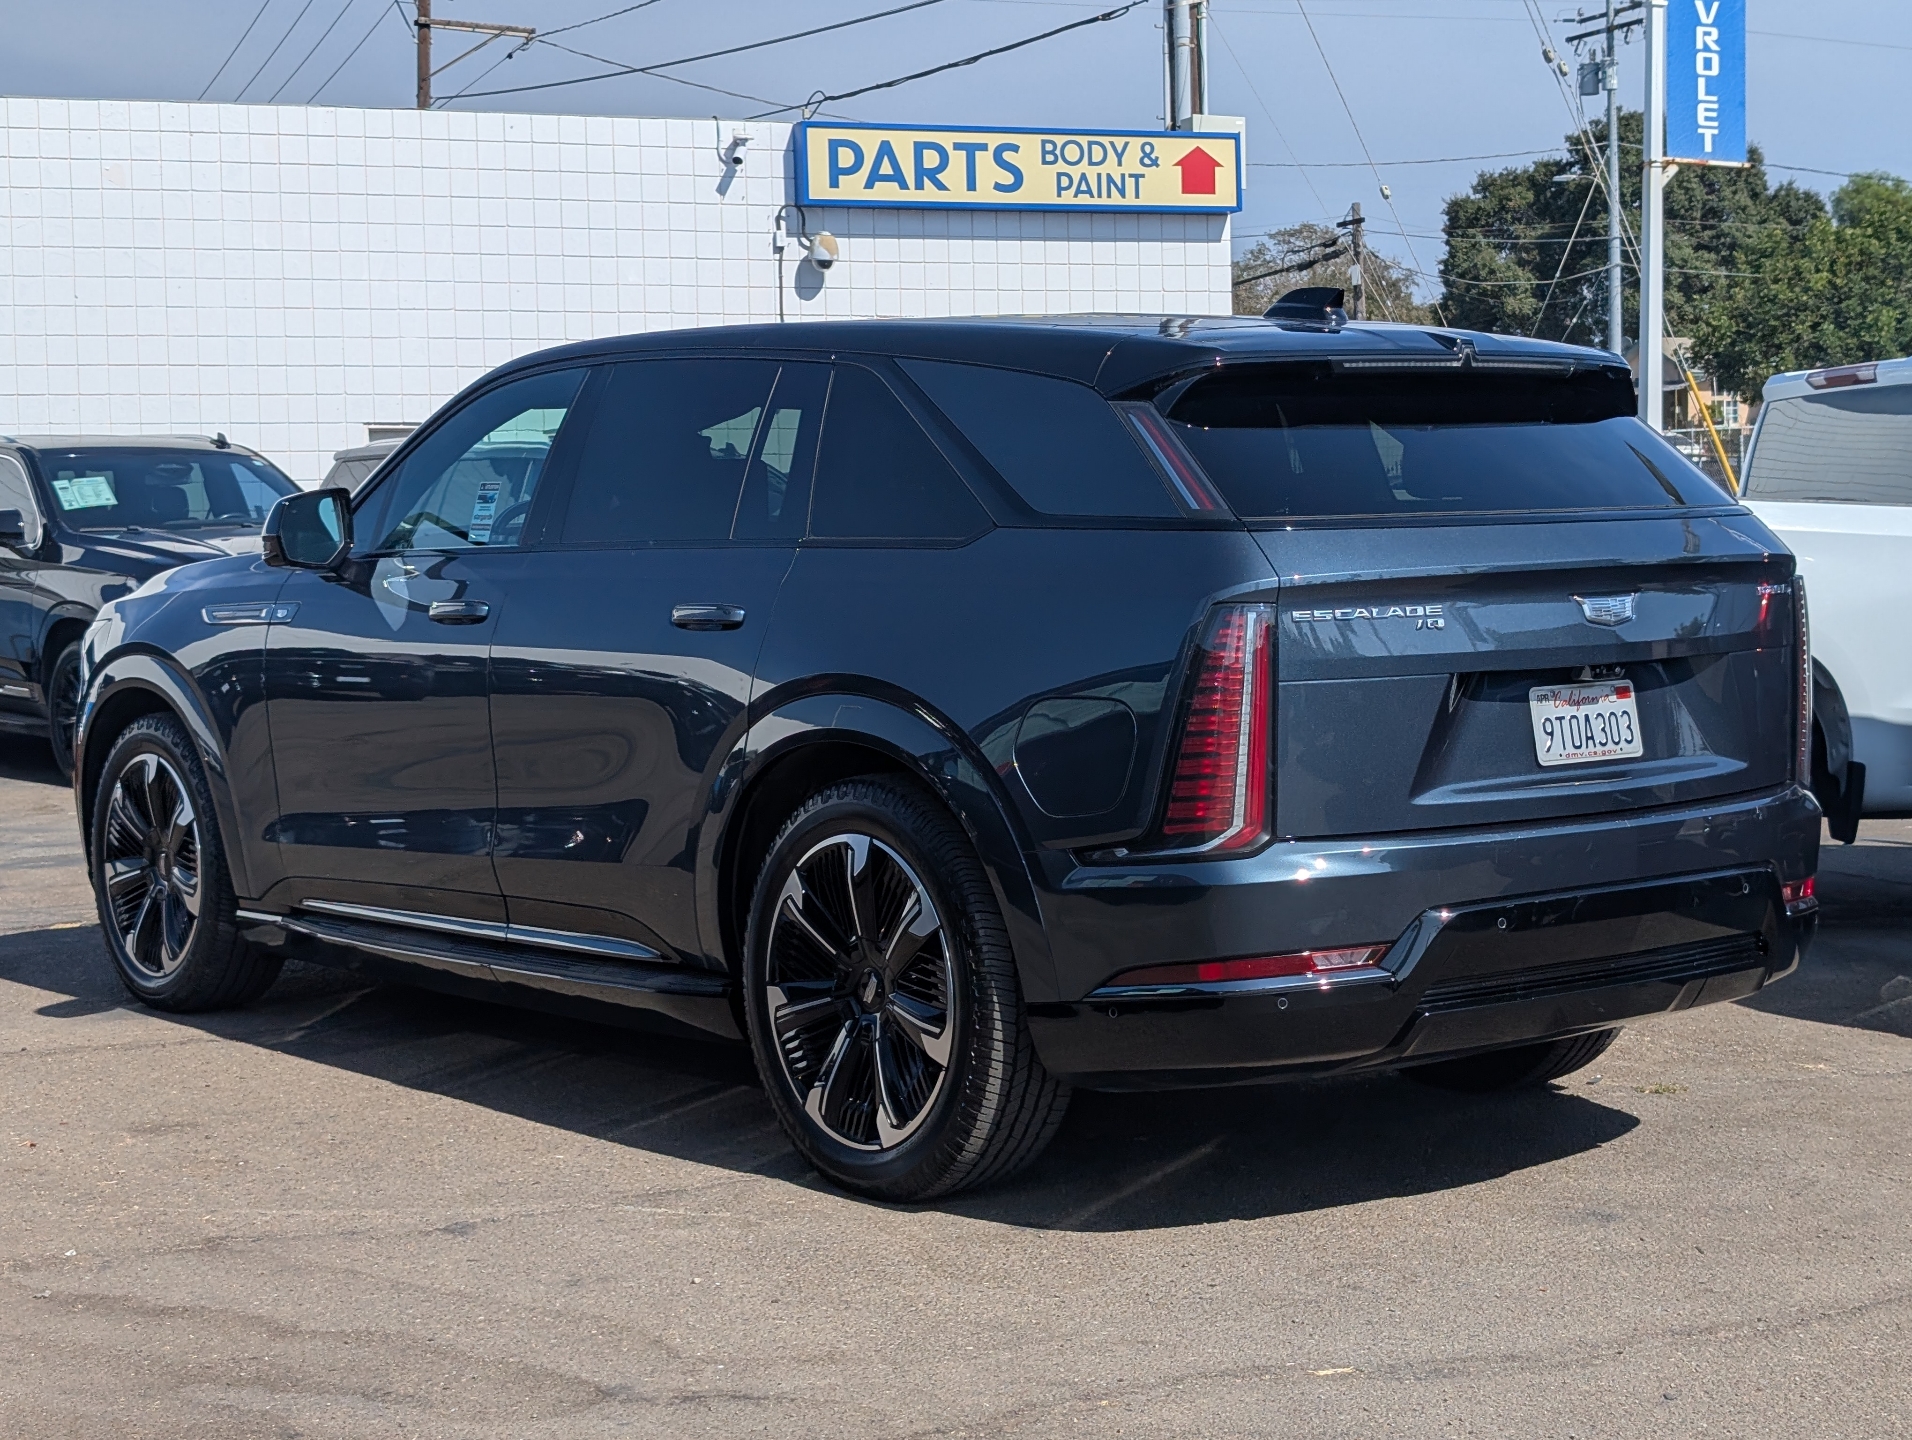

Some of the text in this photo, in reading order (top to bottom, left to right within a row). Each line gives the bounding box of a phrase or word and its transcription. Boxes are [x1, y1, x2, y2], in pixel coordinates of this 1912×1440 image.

[1694, 0, 1721, 153] VROLET
[827, 138, 1024, 194] PARTS
[1040, 139, 1161, 168] BODY &
[1055, 172, 1146, 200] PAINT
[1292, 605, 1443, 622] ESCALADE
[1536, 693, 1550, 705] APR
[1553, 689, 1617, 712] California
[1565, 748, 1618, 759] dmv.ca.gov
